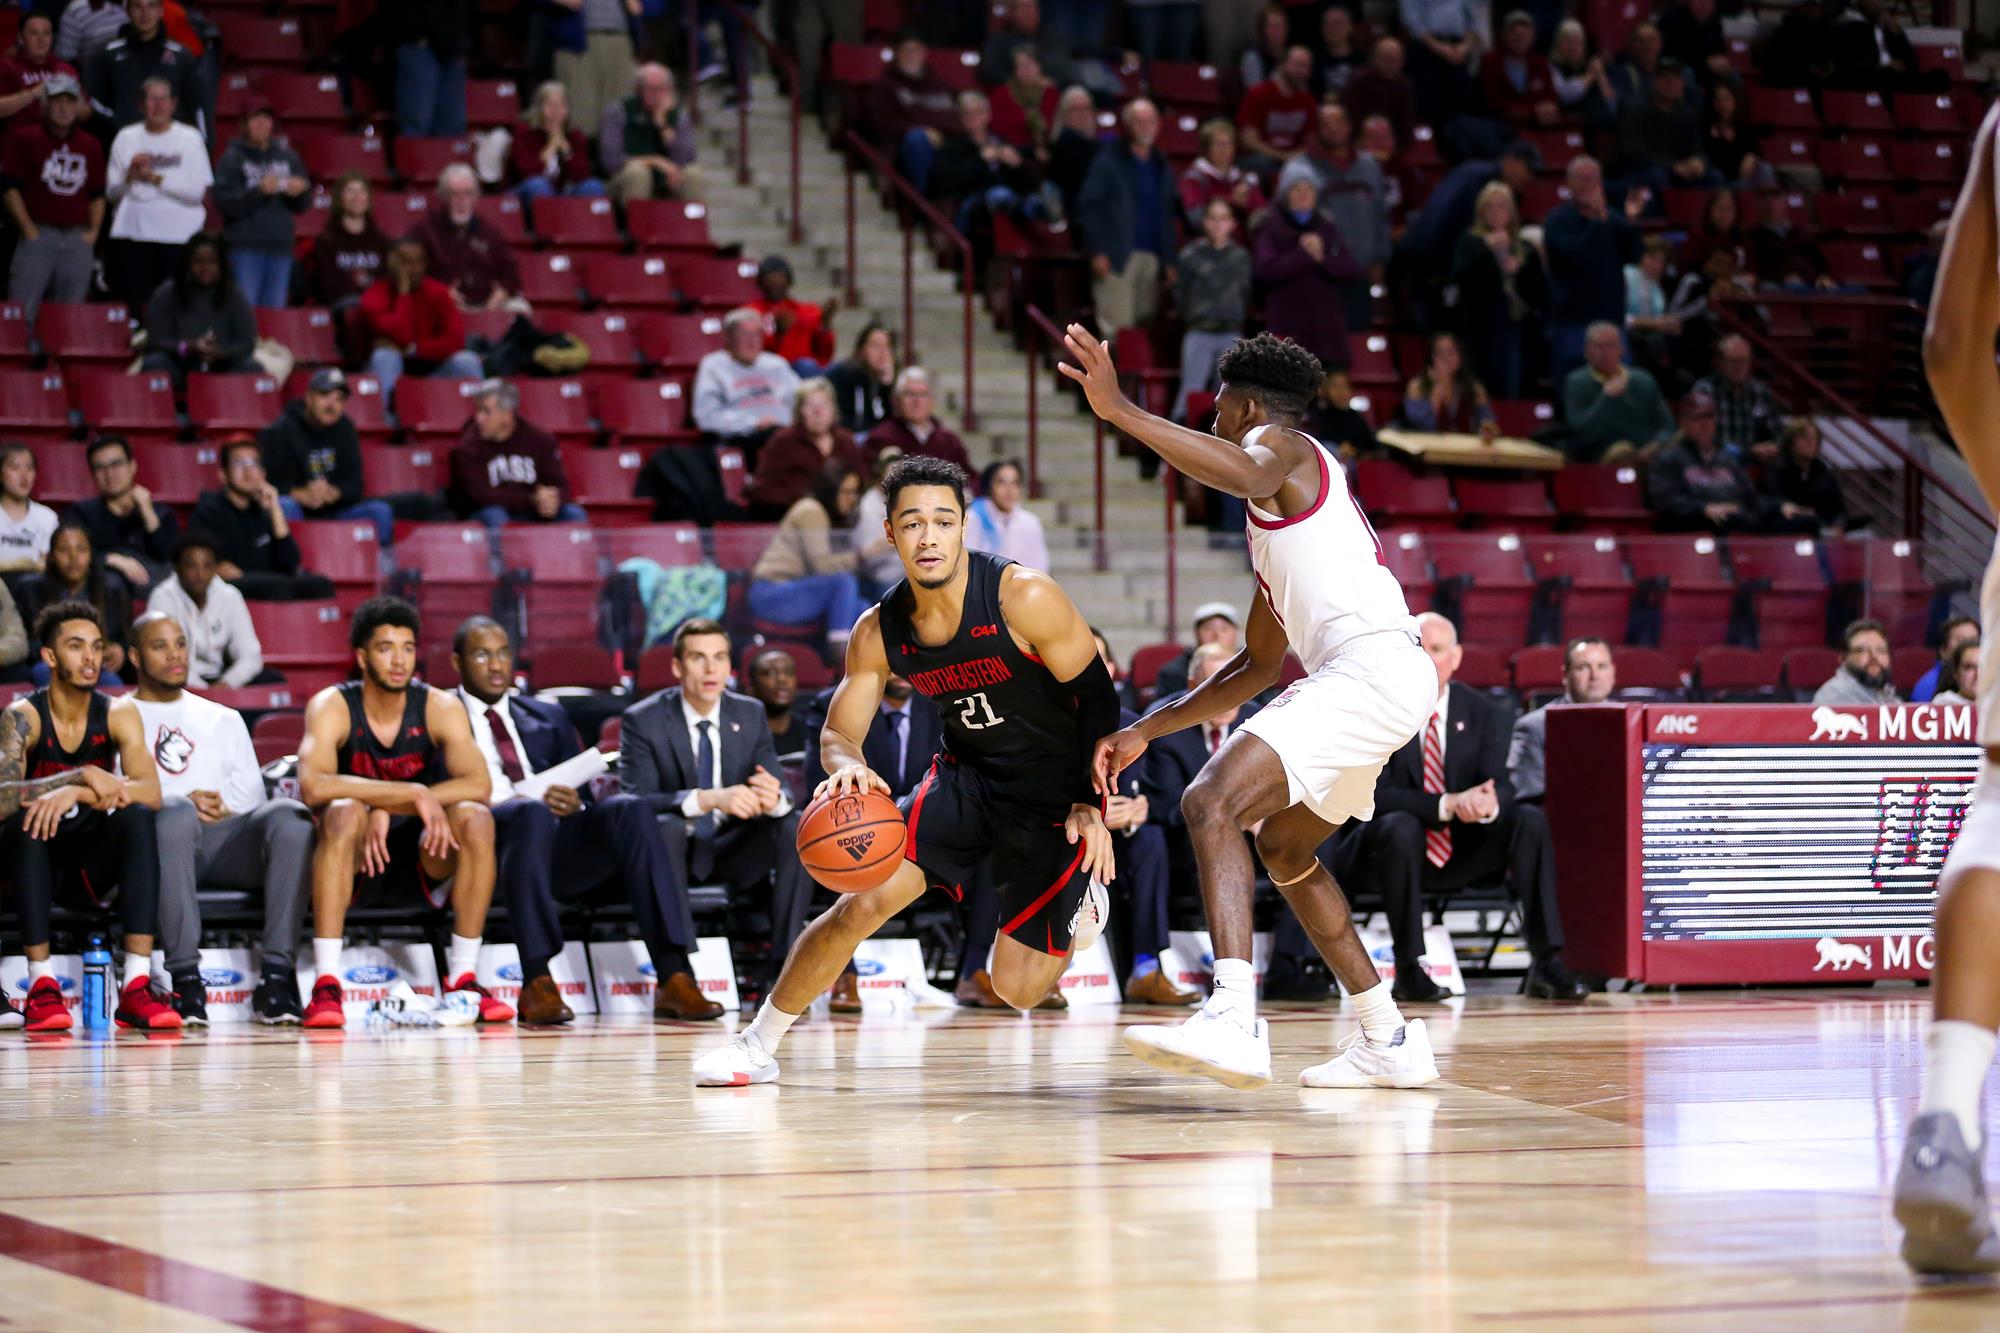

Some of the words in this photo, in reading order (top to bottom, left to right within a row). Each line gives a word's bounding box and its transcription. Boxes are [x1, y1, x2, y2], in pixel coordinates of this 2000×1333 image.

[970, 623, 998, 638] CAA
[908, 655, 1013, 697] NORTHEASTERN
[953, 692, 1005, 730] 21
[1878, 705, 1971, 740] MGM
[1655, 715, 1698, 734] ANC
[836, 831, 875, 847] adidas
[1882, 937, 1936, 970] MG
[355, 970, 388, 983] Ford
